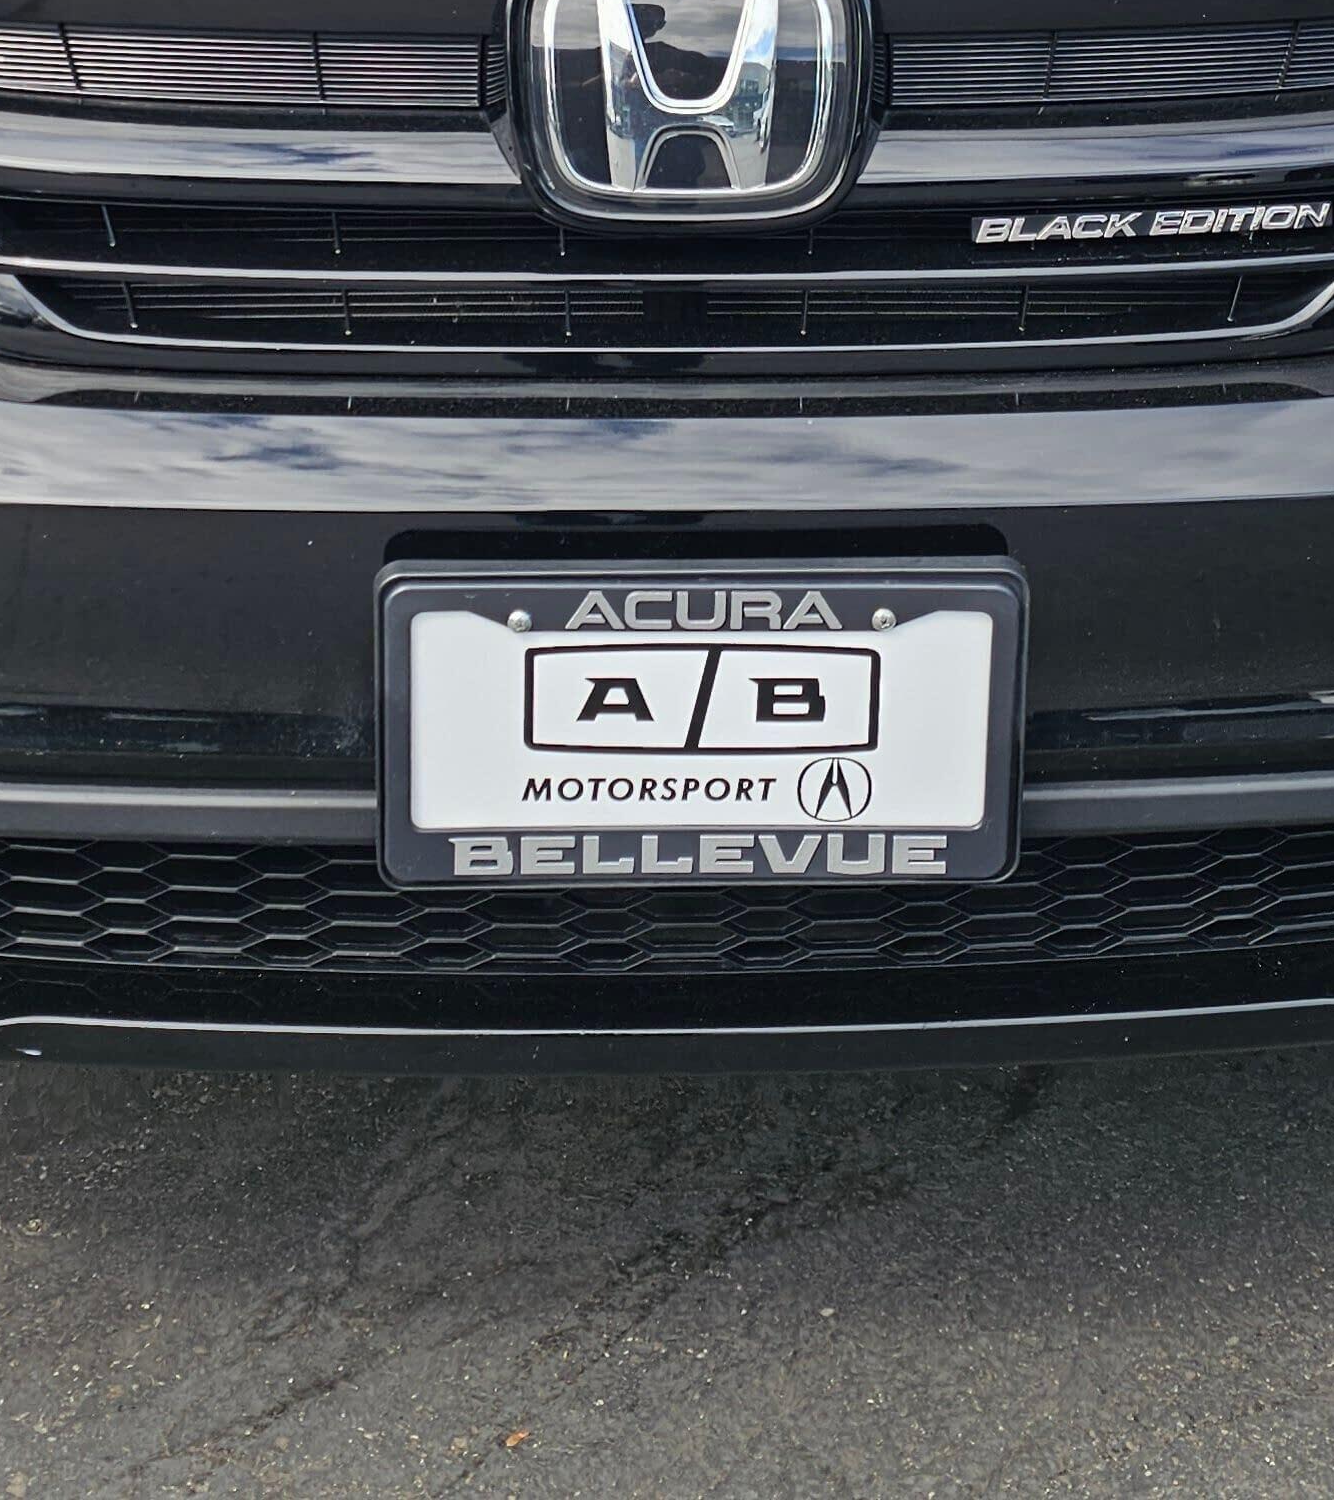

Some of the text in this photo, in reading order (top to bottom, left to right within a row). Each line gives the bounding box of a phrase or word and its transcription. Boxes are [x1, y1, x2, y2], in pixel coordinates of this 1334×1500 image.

[975, 202, 1332, 244] BLACK EDITION
[564, 589, 843, 632] ACURA
[521, 776, 778, 802] MOTORSPORT
[446, 834, 948, 876] BELLEVUE
